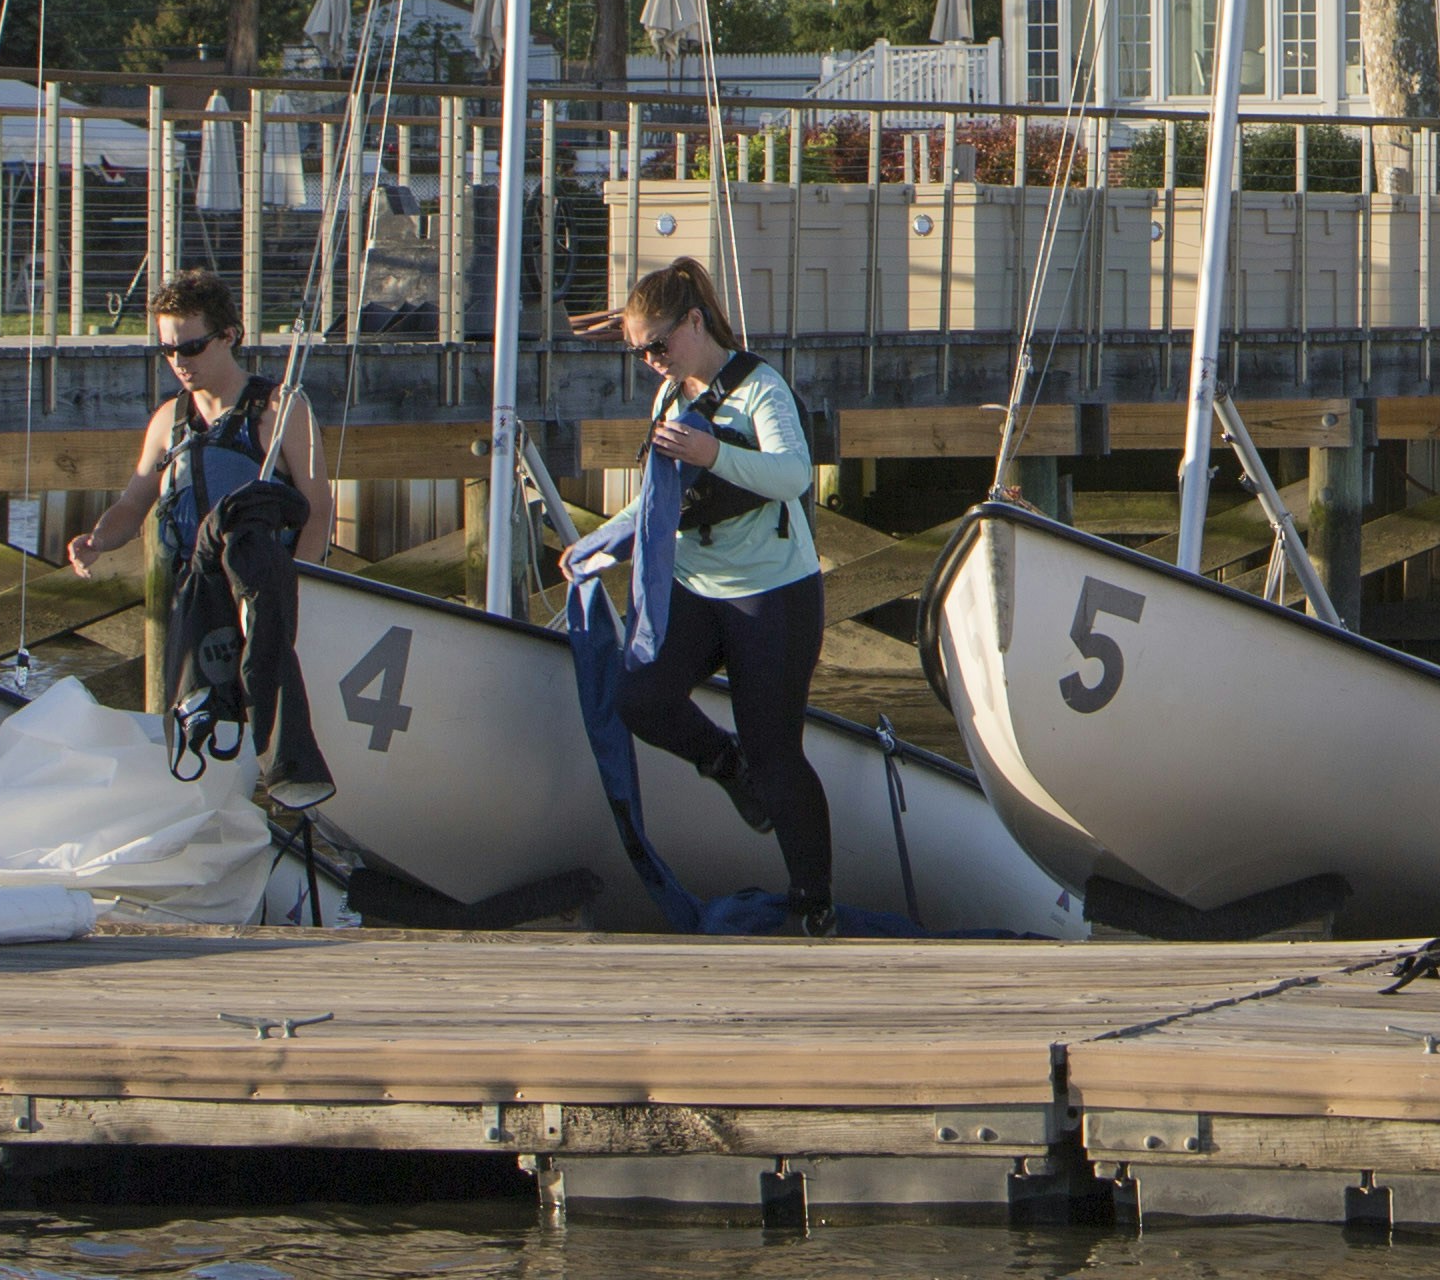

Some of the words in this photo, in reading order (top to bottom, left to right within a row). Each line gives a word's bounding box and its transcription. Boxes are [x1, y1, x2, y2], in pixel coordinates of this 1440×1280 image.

[771, 387, 803, 452] Columb
[339, 626, 413, 752] 4
[1058, 575, 1146, 713] 5
